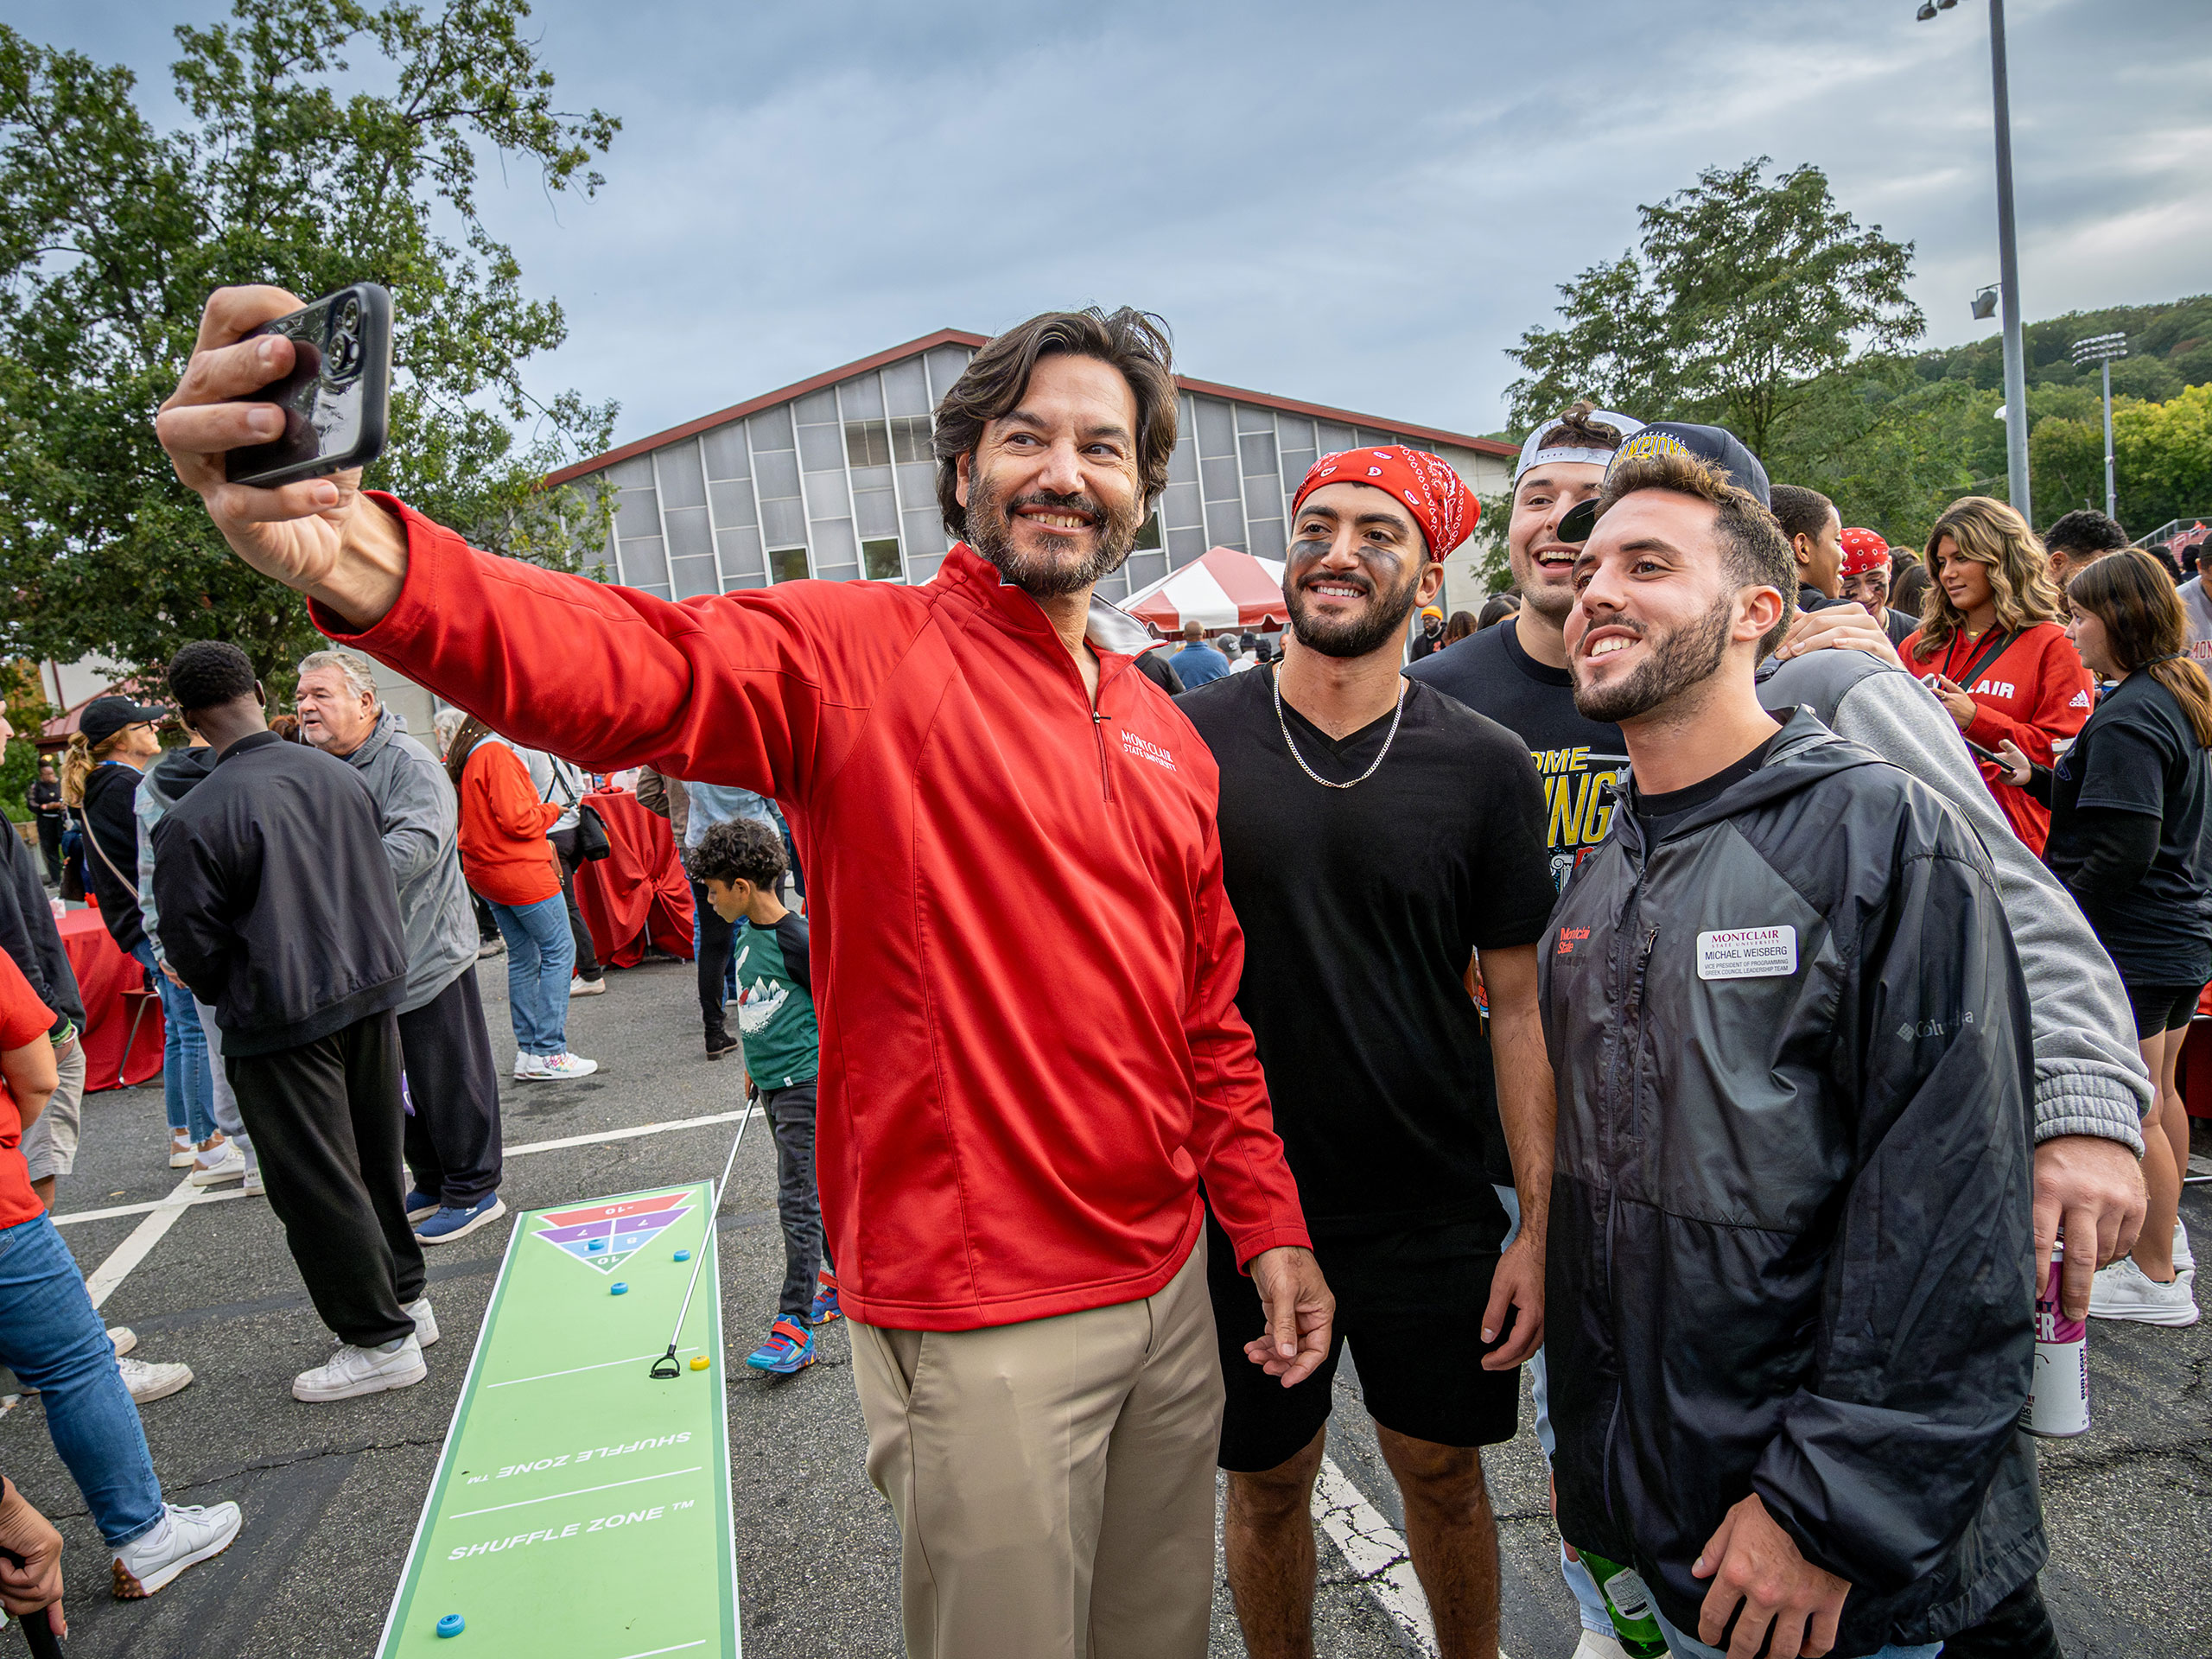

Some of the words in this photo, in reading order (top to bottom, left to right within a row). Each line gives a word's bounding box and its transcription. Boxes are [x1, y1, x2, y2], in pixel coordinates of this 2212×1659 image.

[1122, 729, 1173, 763] MONTCLAIR
[1123, 743, 1144, 758] STATE
[1143, 751, 1177, 772] UNIVERSITY
[1712, 930, 1779, 943] MONTCLAIR
[1705, 950, 1742, 960] MICHAEL
[1743, 946, 1788, 957] WEISBERG
[575, 1431, 692, 1463] SHUFFLE
[495, 1454, 570, 1478] ZONE
[448, 1522, 582, 1560] SHUFFLE
[586, 1506, 665, 1533] ZONE
